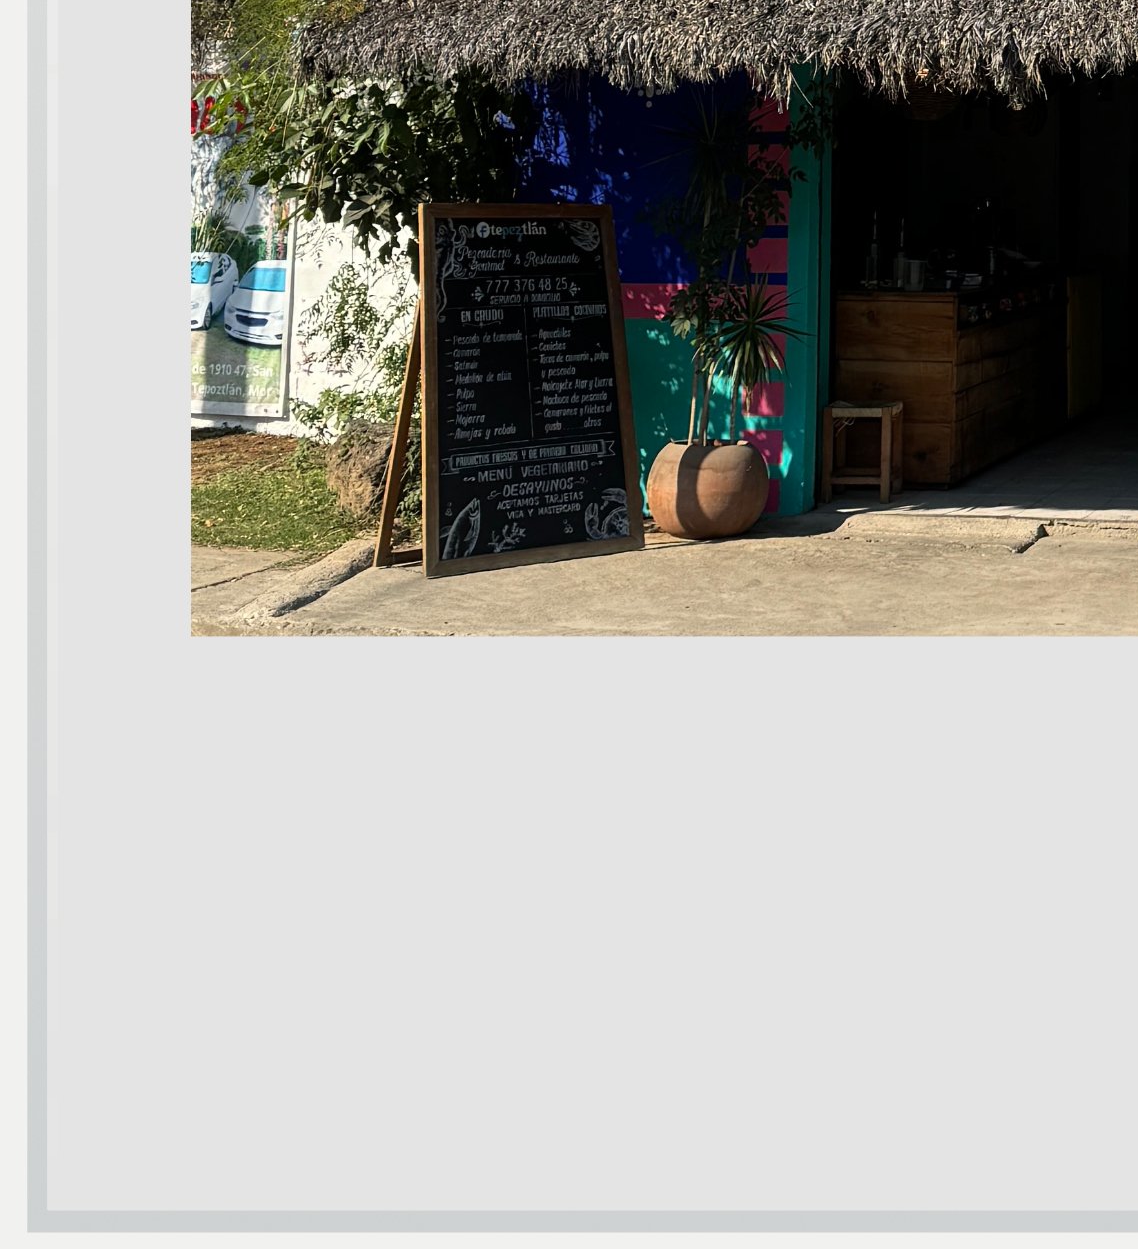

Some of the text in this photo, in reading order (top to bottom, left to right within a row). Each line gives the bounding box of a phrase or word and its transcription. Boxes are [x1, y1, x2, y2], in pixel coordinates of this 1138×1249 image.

[491, 221, 547, 242] tepeztlán
[524, 250, 580, 267] Restaurante
[486, 277, 568, 294] 777 376 48 25
[490, 294, 521, 305] SERVICIO
[460, 308, 504, 322] EN CRUDO
[192, 361, 207, 375] de
[209, 363, 232, 375] 1910
[253, 364, 274, 377] San
[547, 365, 576, 379] pescado
[456, 387, 475, 400] Pulpo
[456, 401, 477, 412] Sierra
[455, 413, 486, 427] Mojarra
[520, 459, 589, 478] VEGETARIANO
[502, 476, 574, 497] DESAYUNOS
[496, 491, 584, 511] ACEPTAMOS TARJETAS
[507, 503, 581, 519] VISA Y MASTERCARD
